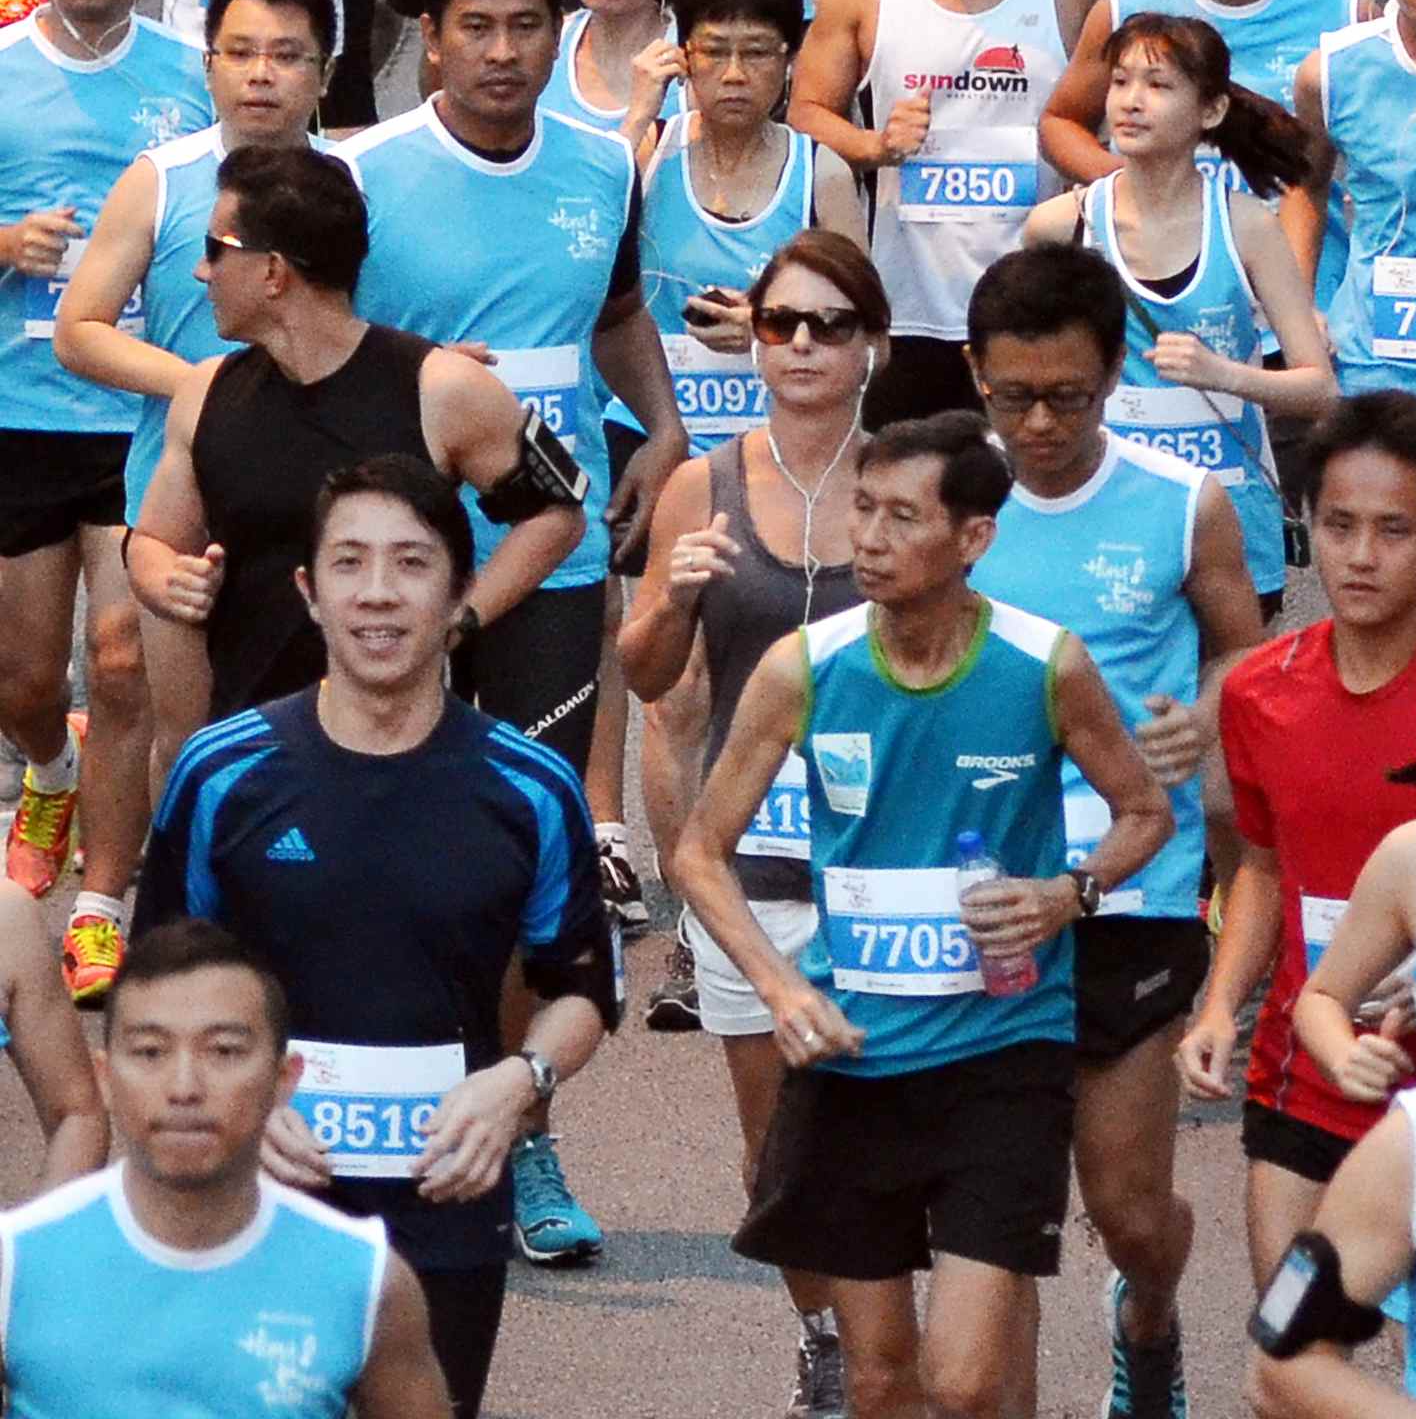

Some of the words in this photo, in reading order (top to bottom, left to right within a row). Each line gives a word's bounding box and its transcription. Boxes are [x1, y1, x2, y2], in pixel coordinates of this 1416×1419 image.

[903, 70, 1029, 94] sundown
[920, 167, 1016, 204] 7850
[678, 377, 771, 418] 3097
[956, 754, 1036, 769] BROOKS
[265, 848, 316, 861] adidas
[851, 923, 971, 969] 7705
[314, 1101, 439, 1150] 8519
